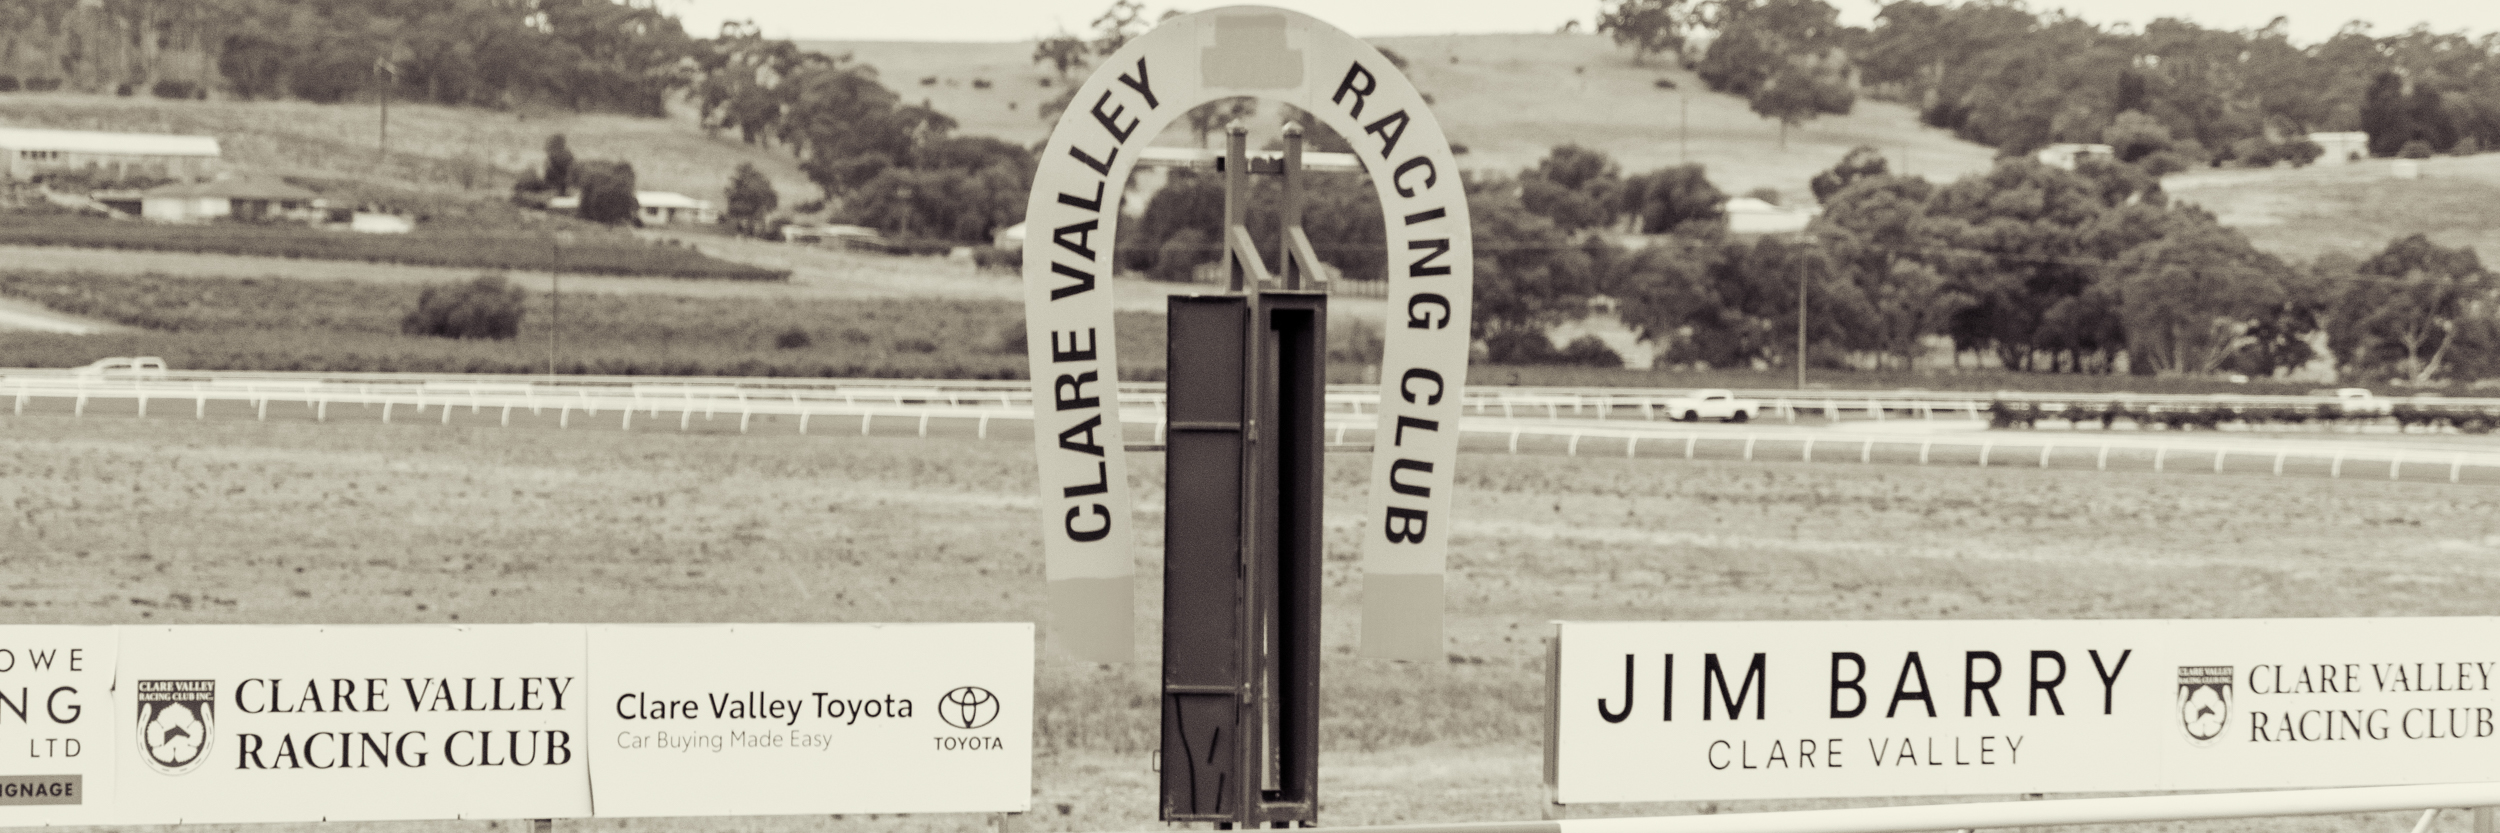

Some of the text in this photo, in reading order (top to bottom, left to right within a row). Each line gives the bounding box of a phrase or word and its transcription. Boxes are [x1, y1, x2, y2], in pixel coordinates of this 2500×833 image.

[1050, 56, 1160, 544] CLARE VALLEY
[1332, 60, 1452, 545] RACING CLUB
[139, 681, 214, 692] CLARE VALLEY
[234, 676, 575, 715] CLARE VALLEY
[1597, 648, 2133, 725] JIM BARRY
[2248, 661, 2496, 695] CLARE VALLEY
[139, 692, 171, 701] RACING
[171, 692, 196, 701] CLUB
[615, 690, 913, 727] Clare Valley Toyota
[616, 729, 833, 754] Car Buying Made Easy
[2249, 706, 2494, 743] RACING CLUB
[30, 738, 81, 758] LTD
[235, 729, 572, 770] RACING CLUB
[933, 736, 1004, 751] TOYOTA
[1708, 735, 2024, 771] CLARE VALLEY
